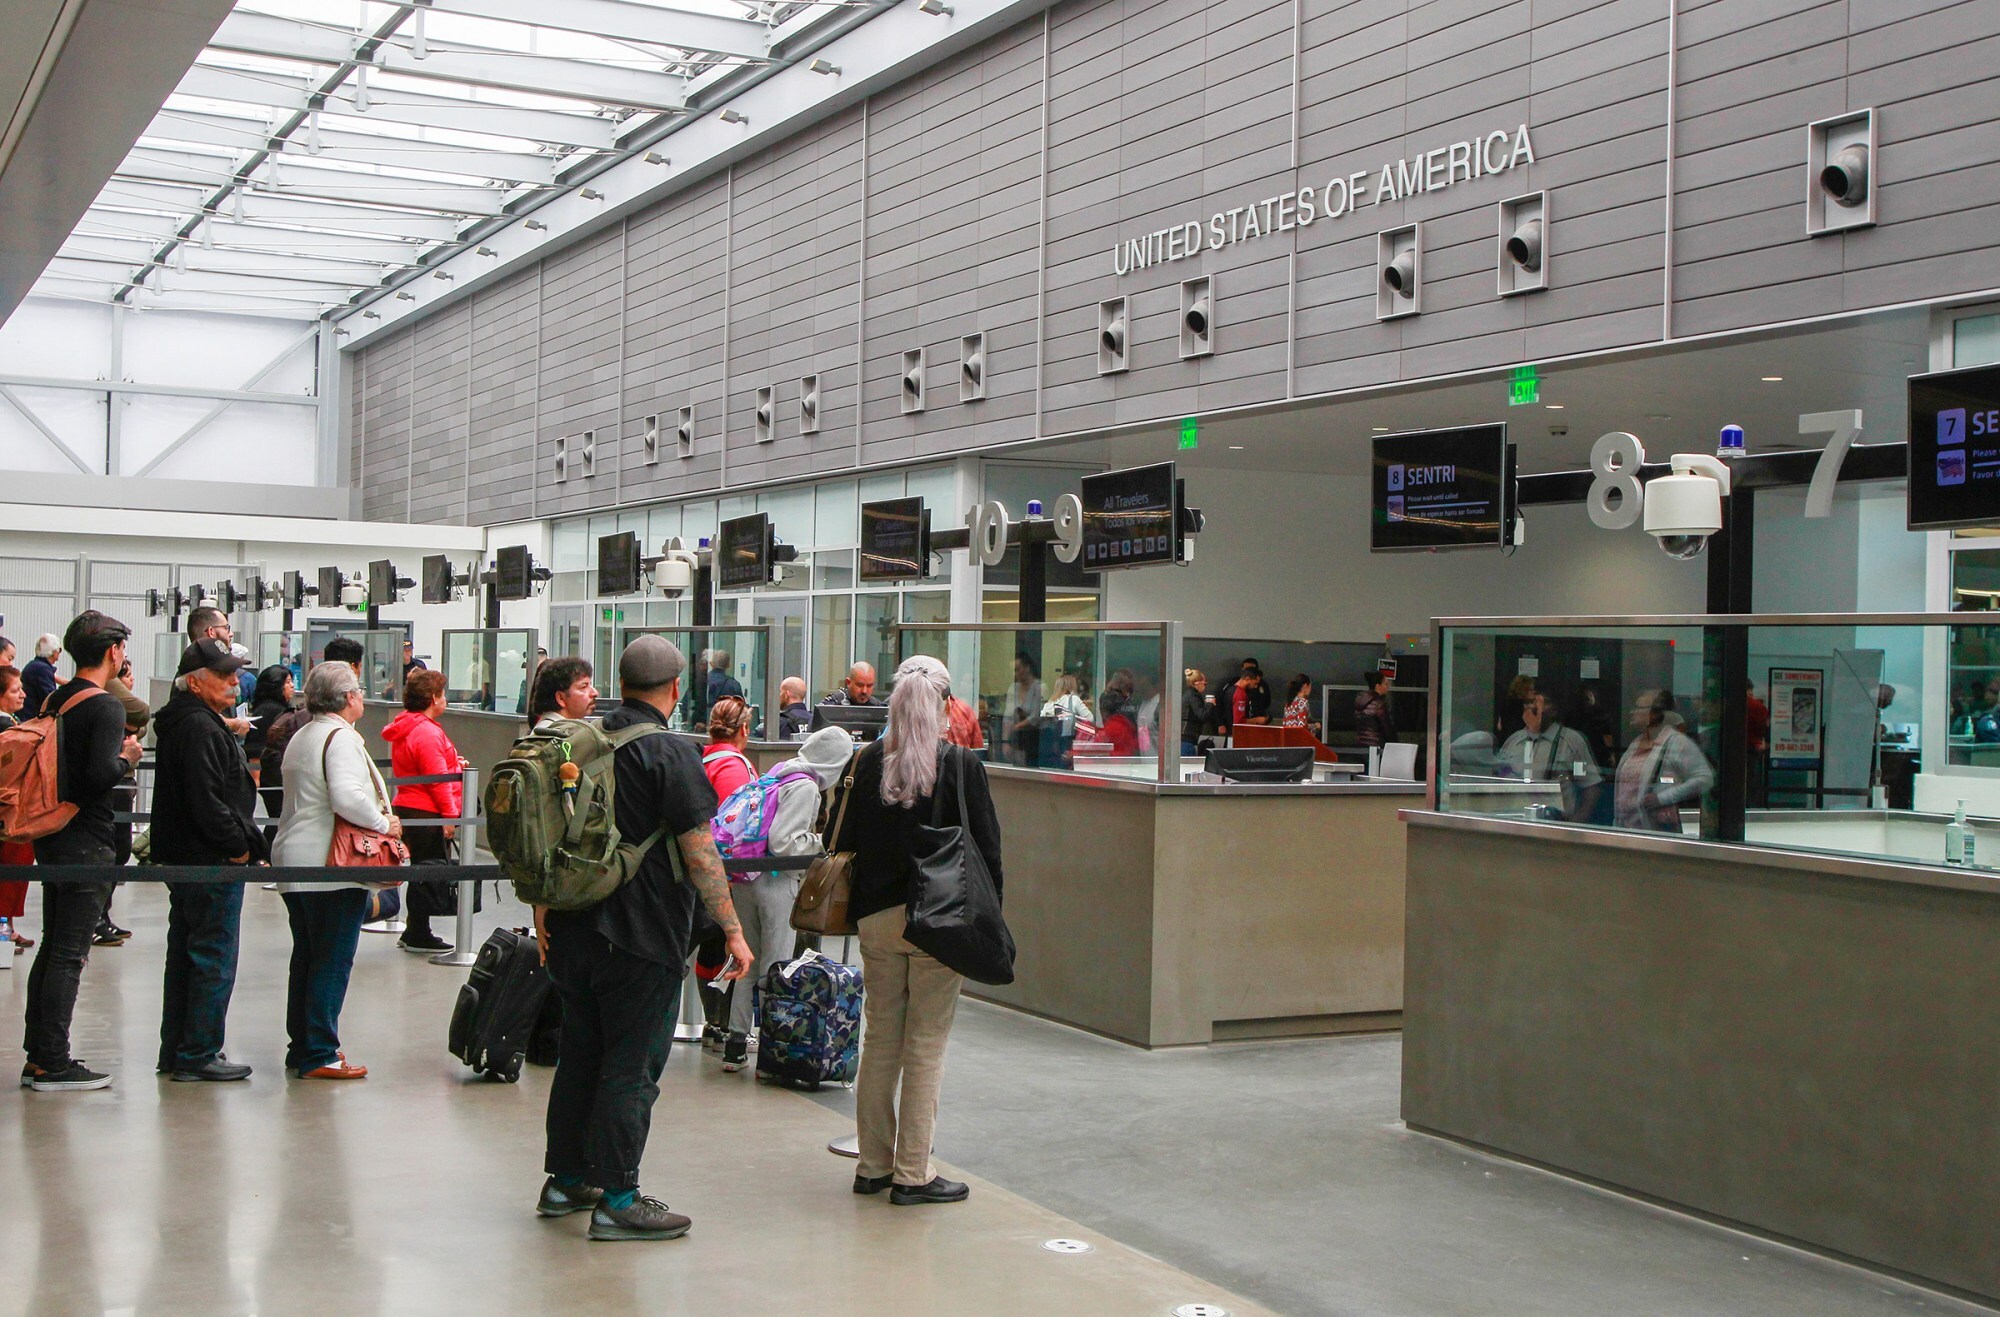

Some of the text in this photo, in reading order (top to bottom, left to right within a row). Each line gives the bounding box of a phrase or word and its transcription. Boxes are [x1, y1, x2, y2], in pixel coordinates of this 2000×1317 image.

[1114, 124, 1535, 275] UNITED STATES OF AMERICA
[1515, 380, 1537, 403] EXIT
[1945, 417, 1957, 436] 7
[1798, 408, 1863, 518] 7
[1972, 449, 1997, 458] Please
[1393, 471, 1399, 484] 8
[1408, 465, 1455, 485] SENTRI
[1586, 431, 1644, 530] 8
[1972, 471, 1994, 479] Favor
[1104, 492, 1149, 510] All Travelers
[965, 500, 1007, 566] 10
[1053, 493, 1083, 564] 9
